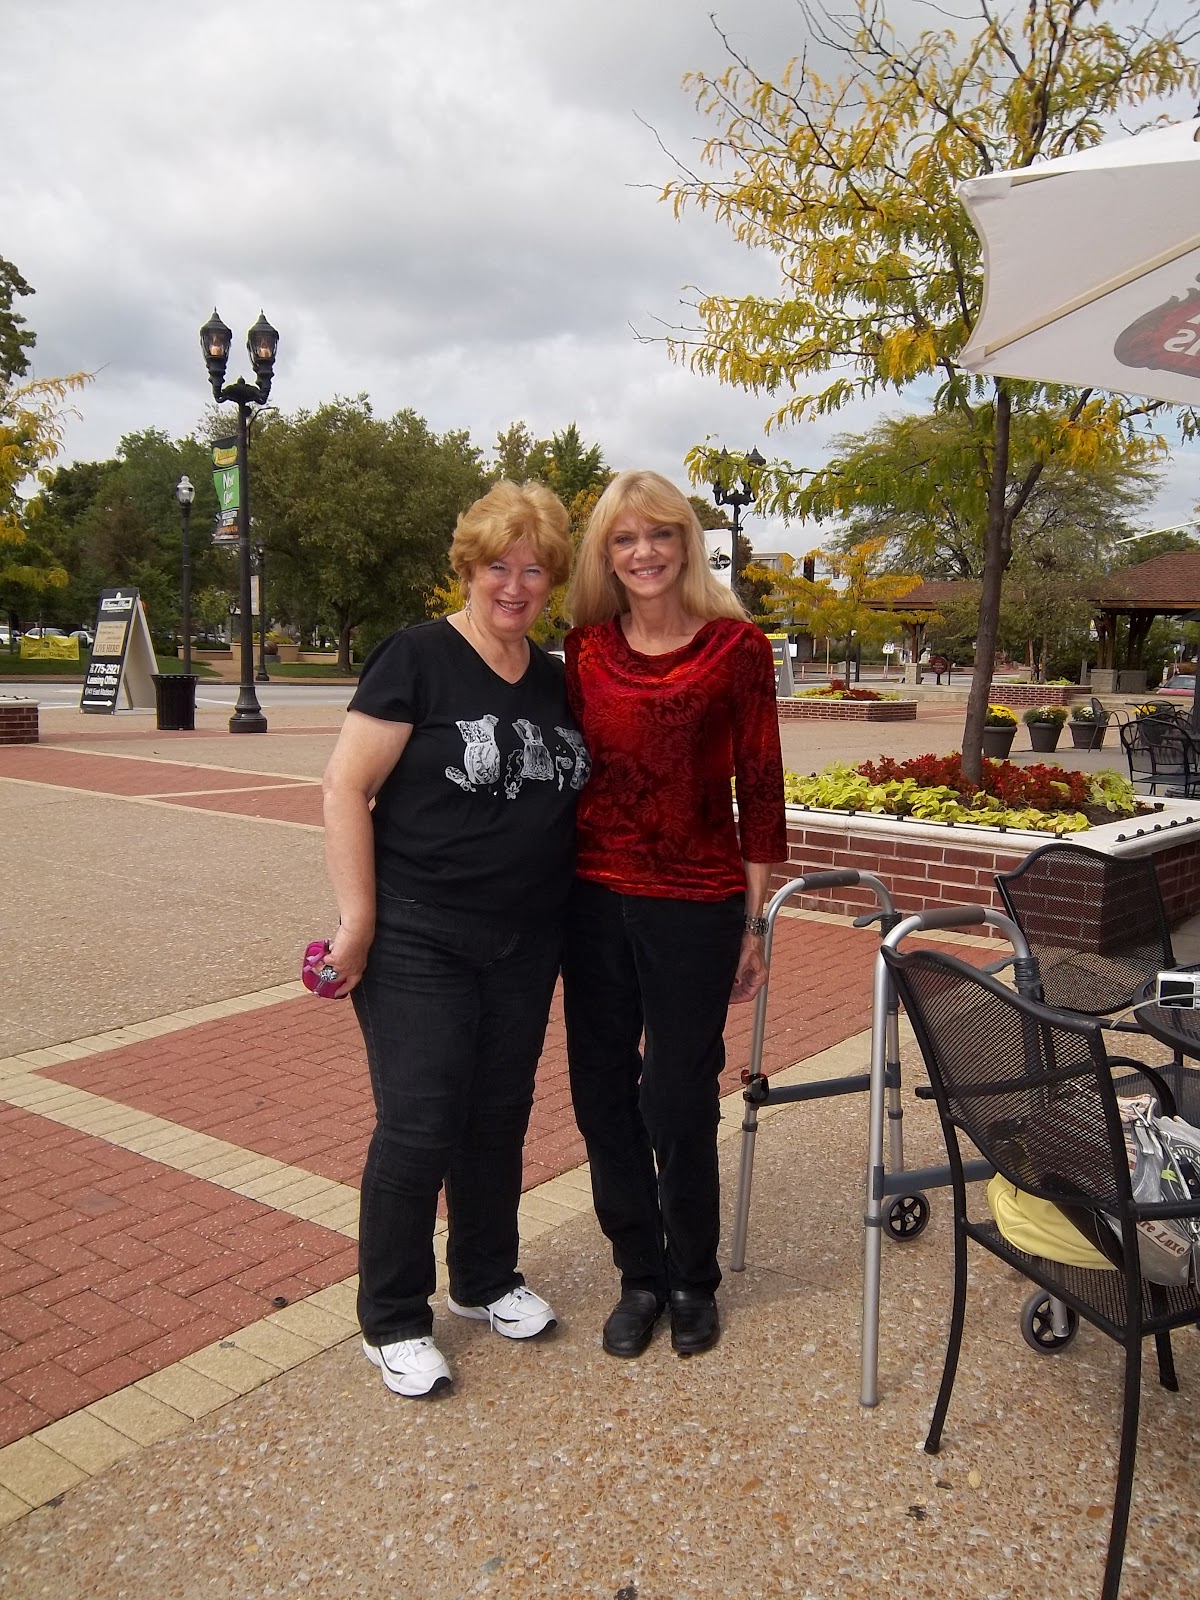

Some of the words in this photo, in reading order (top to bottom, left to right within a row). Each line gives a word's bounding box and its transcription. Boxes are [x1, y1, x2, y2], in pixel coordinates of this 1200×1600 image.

[94, 663, 120, 675] 775-2921
[87, 675, 104, 687] Leasing
[104, 675, 118, 685] Office
[1154, 1231, 1185, 1255] Luxe
